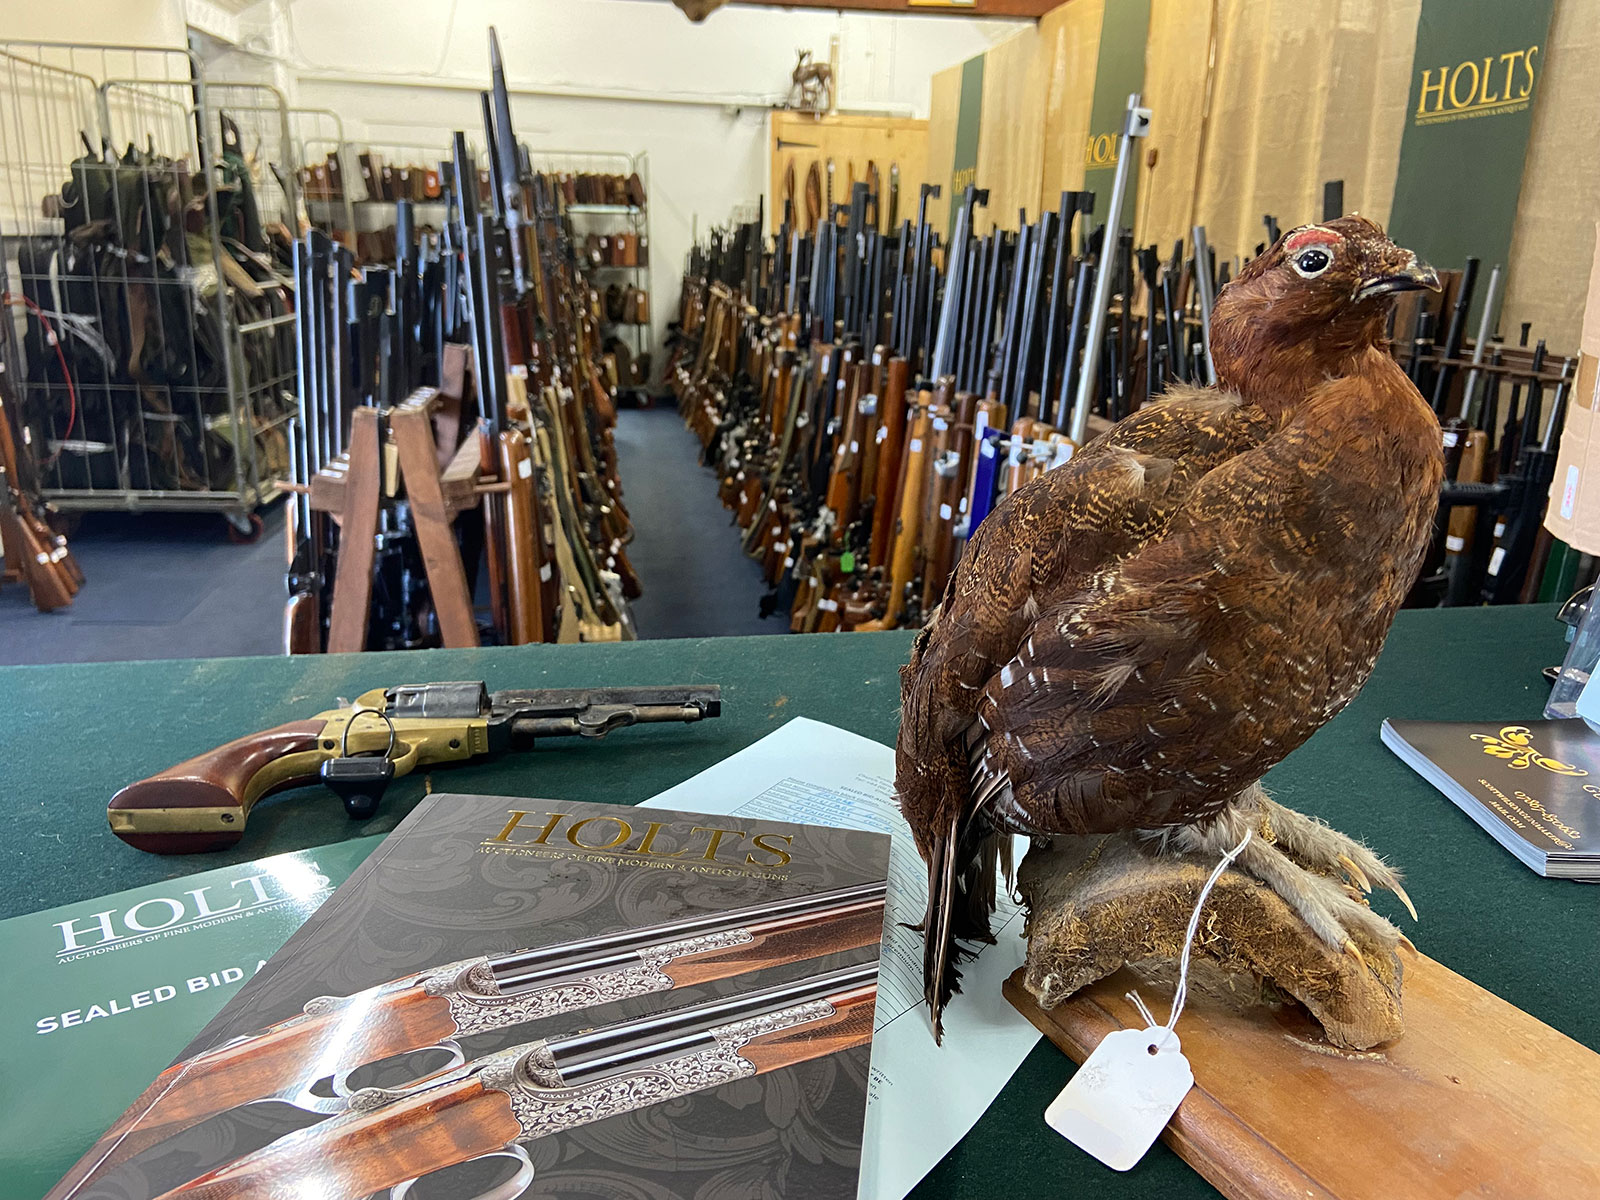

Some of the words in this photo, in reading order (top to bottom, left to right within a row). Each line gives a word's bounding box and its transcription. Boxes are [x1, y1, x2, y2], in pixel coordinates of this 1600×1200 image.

[1416, 45, 1539, 114] HOLTS
[476, 846, 565, 860] AUCTIONEERS
[586, 855, 617, 865] FINE
[617, 858, 676, 871] MODERN
[488, 810, 795, 868] HOLTS
[52, 861, 331, 954] HOLT
[58, 938, 143, 965] AUCTIONEERS
[145, 934, 161, 943] OF
[163, 926, 191, 938] FINE
[193, 913, 243, 931] MODERN
[245, 909, 254, 917] &
[36, 985, 177, 1035] SEALED
[186, 966, 244, 994] BID
